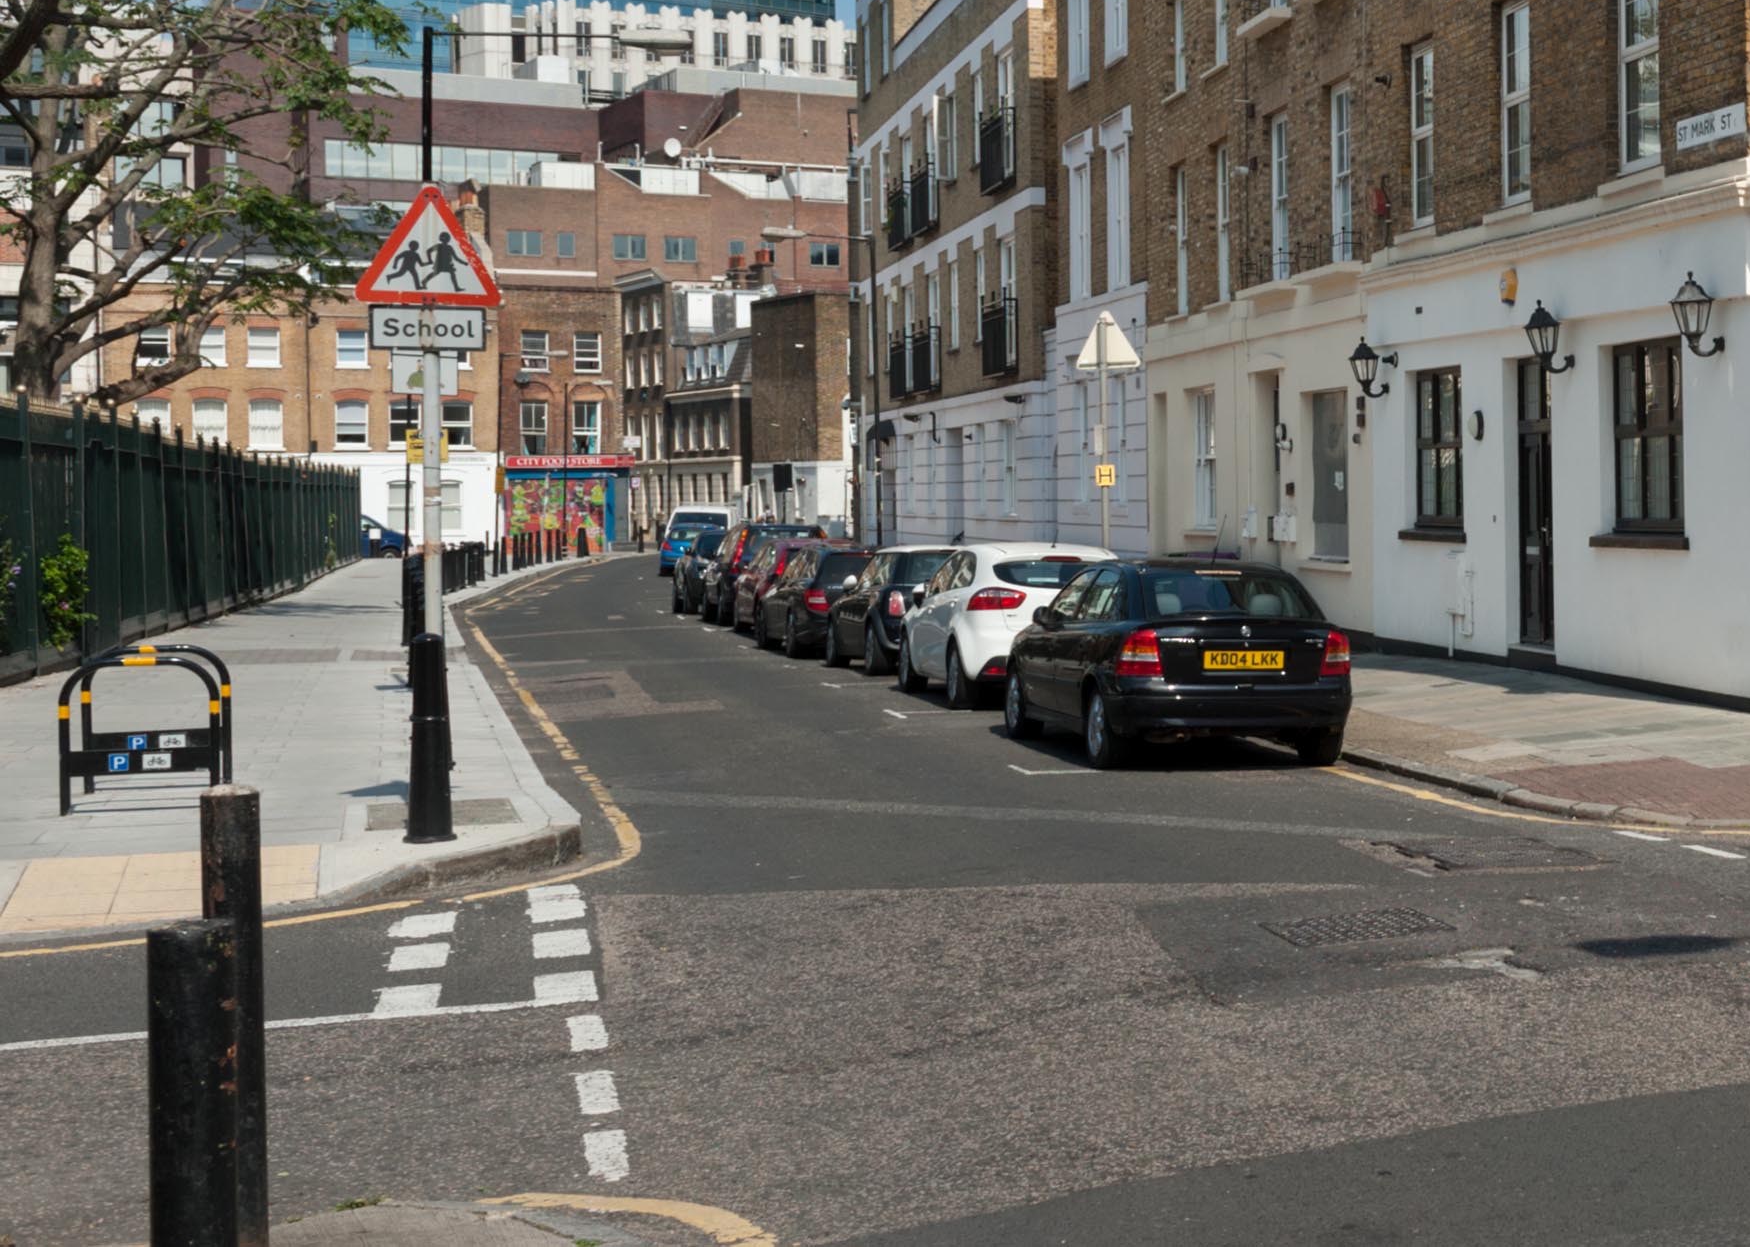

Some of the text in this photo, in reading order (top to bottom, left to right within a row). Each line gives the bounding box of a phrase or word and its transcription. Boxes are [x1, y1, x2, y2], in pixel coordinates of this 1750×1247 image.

[1678, 126, 1688, 142] ST
[1691, 118, 1716, 138] MARK
[1721, 113, 1732, 130] ST
[383, 318, 475, 338] School
[516, 457, 602, 466] CITY FOOD STORE
[1098, 467, 1113, 484] H
[1210, 653, 1279, 666] KD04 LKK
[132, 737, 145, 750] P
[113, 756, 126, 770] P
